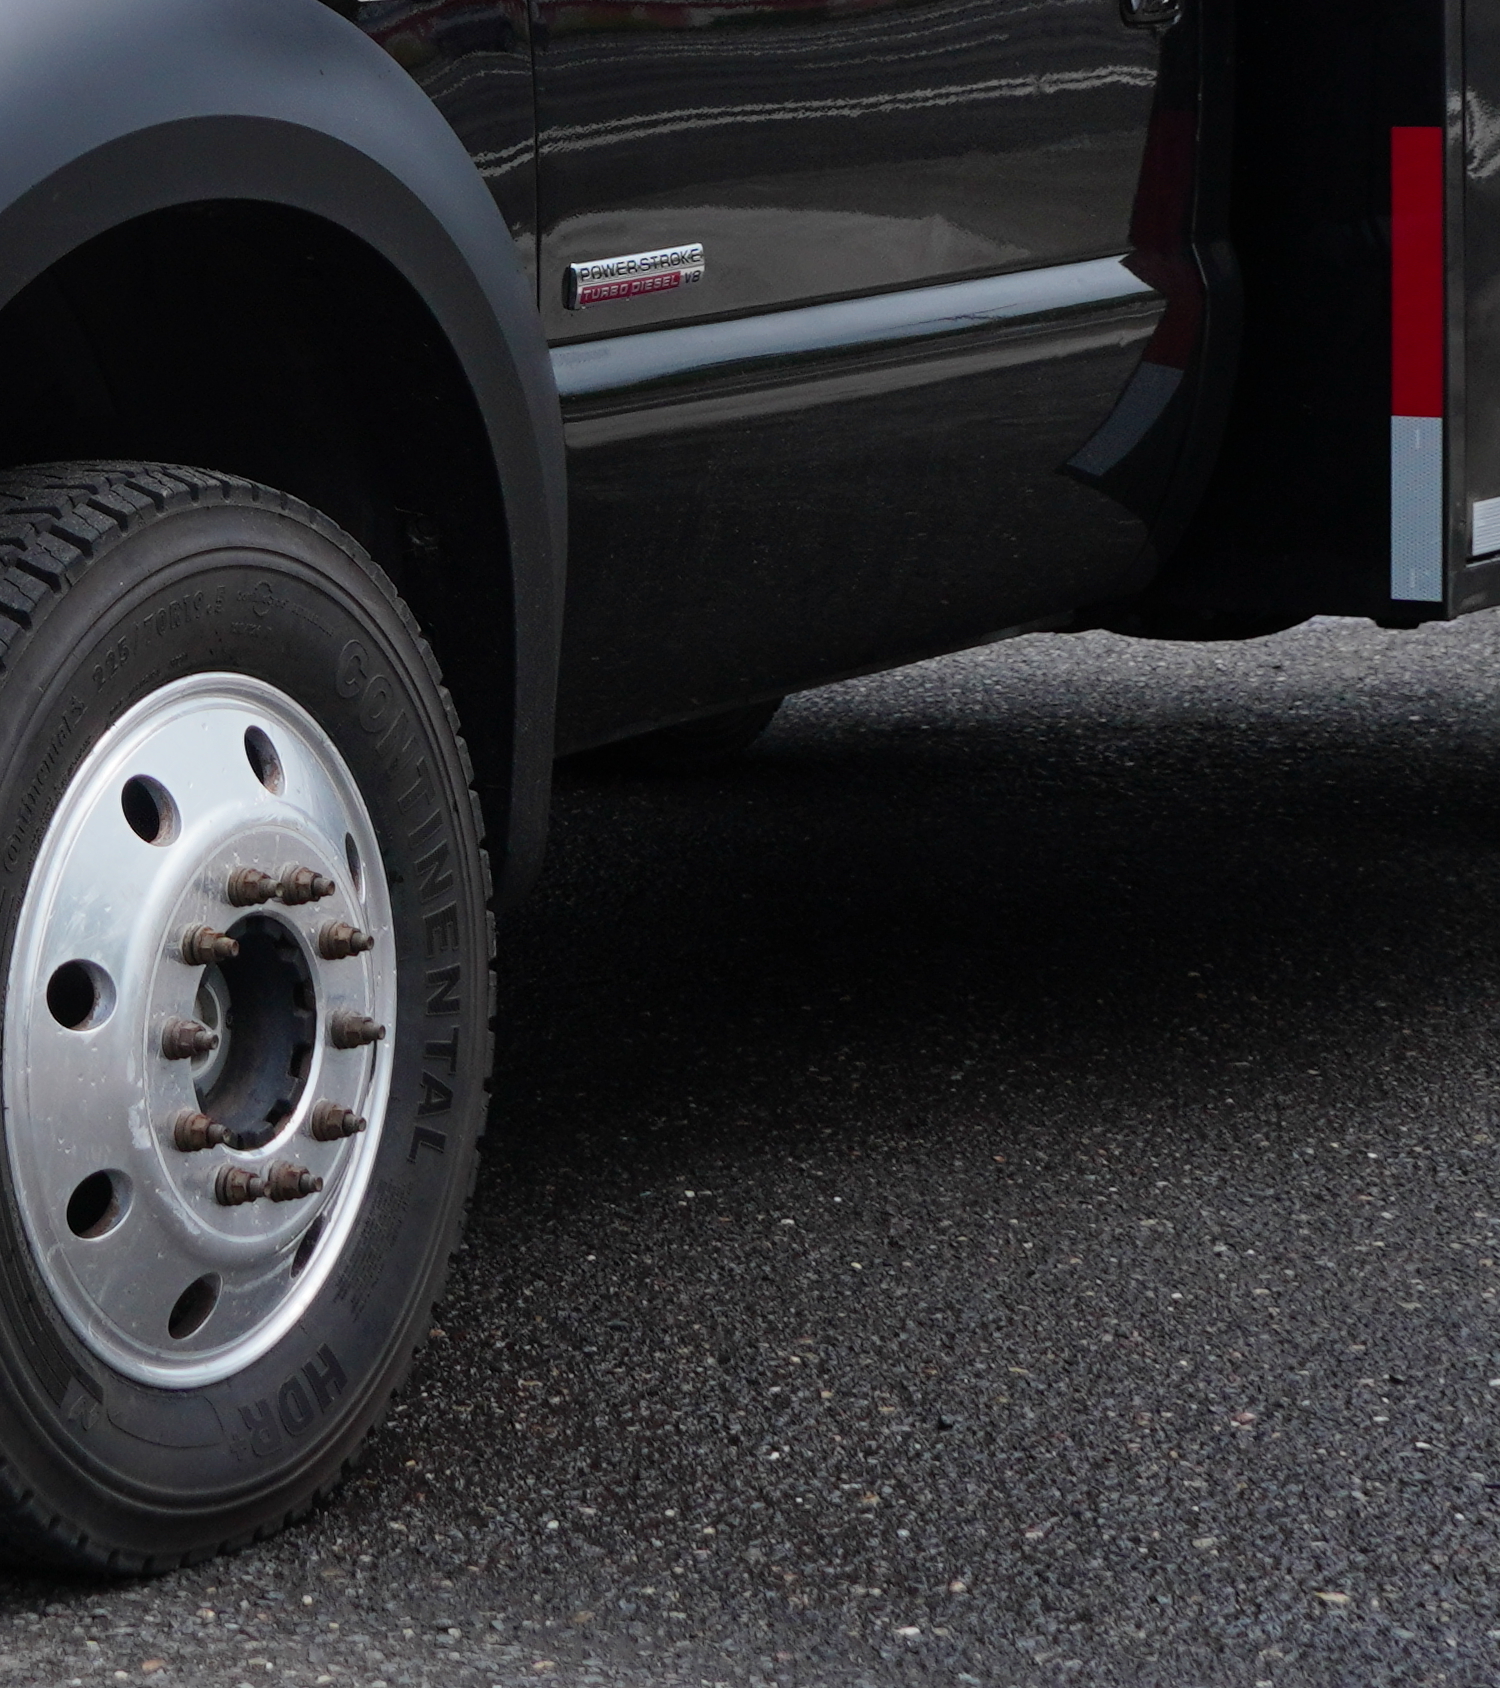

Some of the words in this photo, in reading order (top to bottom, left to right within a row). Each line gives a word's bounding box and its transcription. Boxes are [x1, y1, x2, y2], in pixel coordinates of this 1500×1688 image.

[583, 284, 629, 300] TURBO
[631, 275, 679, 293] DIESEL
[684, 270, 701, 284] V8
[334, 638, 461, 1165] CONTINENTAL
